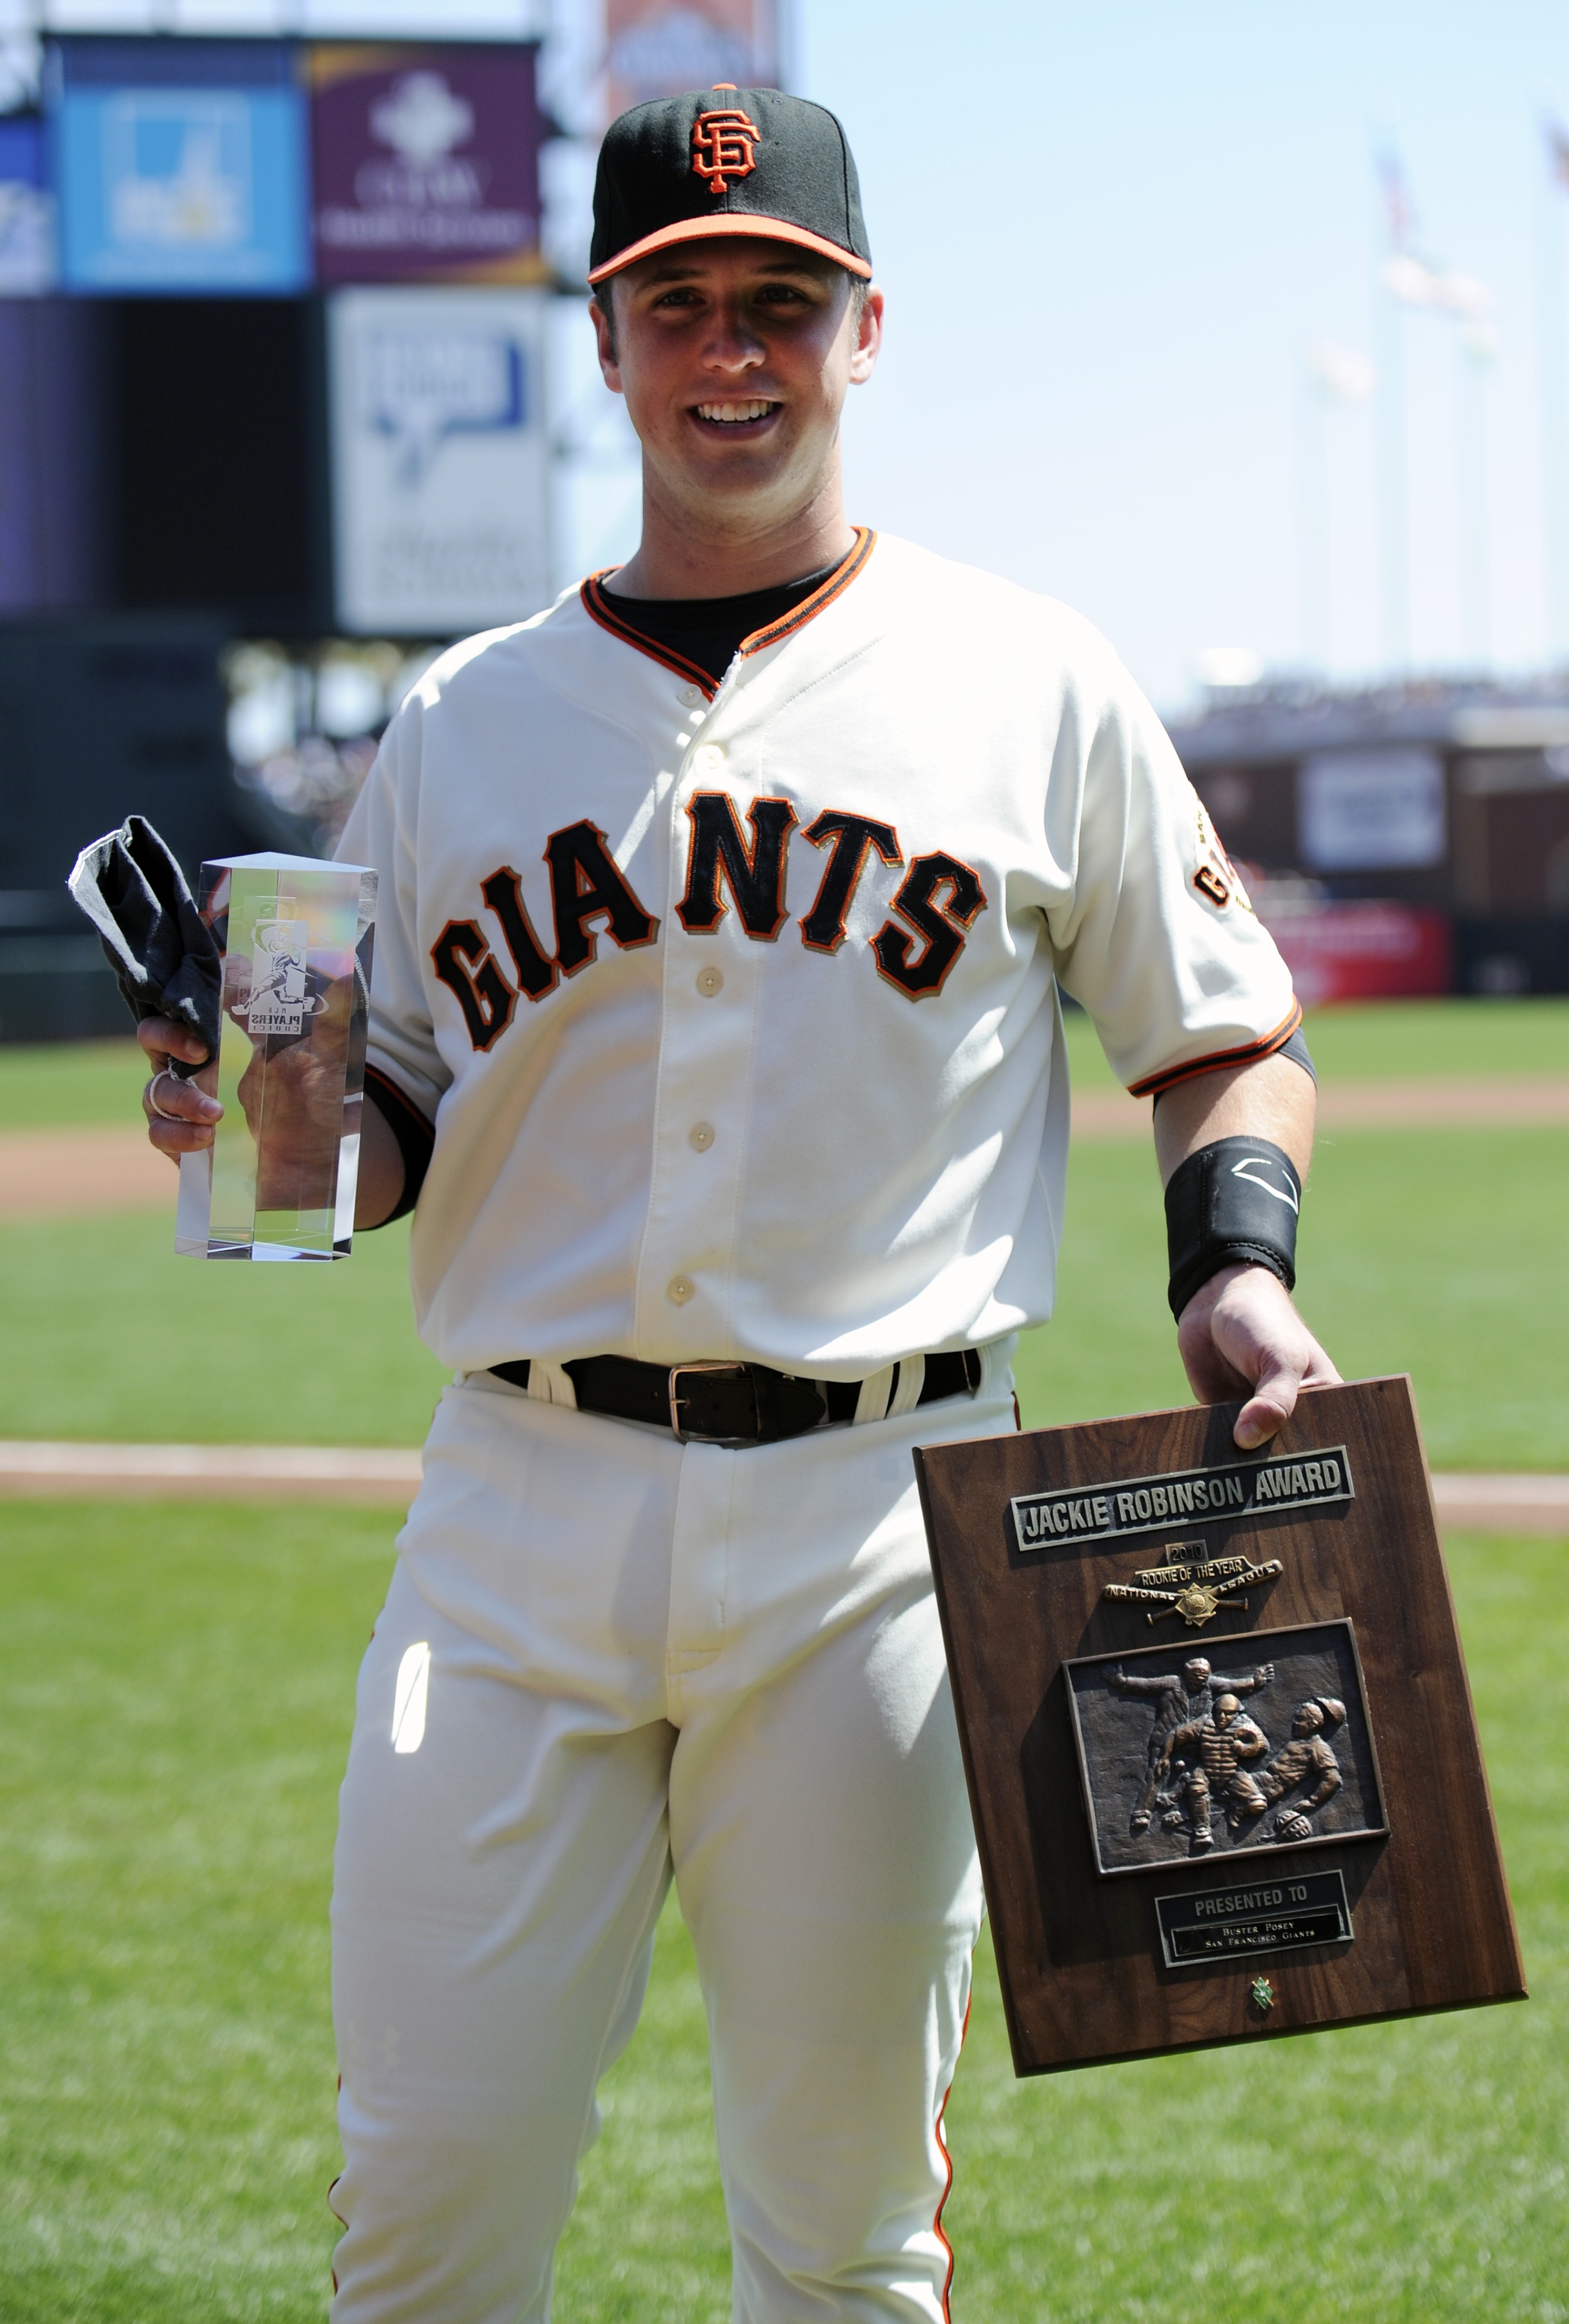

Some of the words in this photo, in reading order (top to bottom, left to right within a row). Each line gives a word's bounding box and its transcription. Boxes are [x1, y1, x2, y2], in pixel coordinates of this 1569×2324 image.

[692, 109, 762, 194] SF
[429, 790, 989, 1054] GIANTS
[1025, 1496, 1110, 1538] JACKIE
[1118, 1476, 1245, 1523] ROBINSON
[1255, 1459, 1342, 1501] AWARD
[1171, 1544, 1203, 1562] 2010
[1108, 1587, 1176, 1602] NATIONAL
[1218, 1564, 1277, 1593] LEAGUE
[1142, 1569, 1178, 1587] ROOKIE
[1179, 1567, 1193, 1582] OF
[1196, 1564, 1215, 1579] THE
[1215, 1559, 1243, 1576] YEAR
[1195, 1889, 1283, 1917] PRESENTED
[1287, 1885, 1308, 1902] TO
